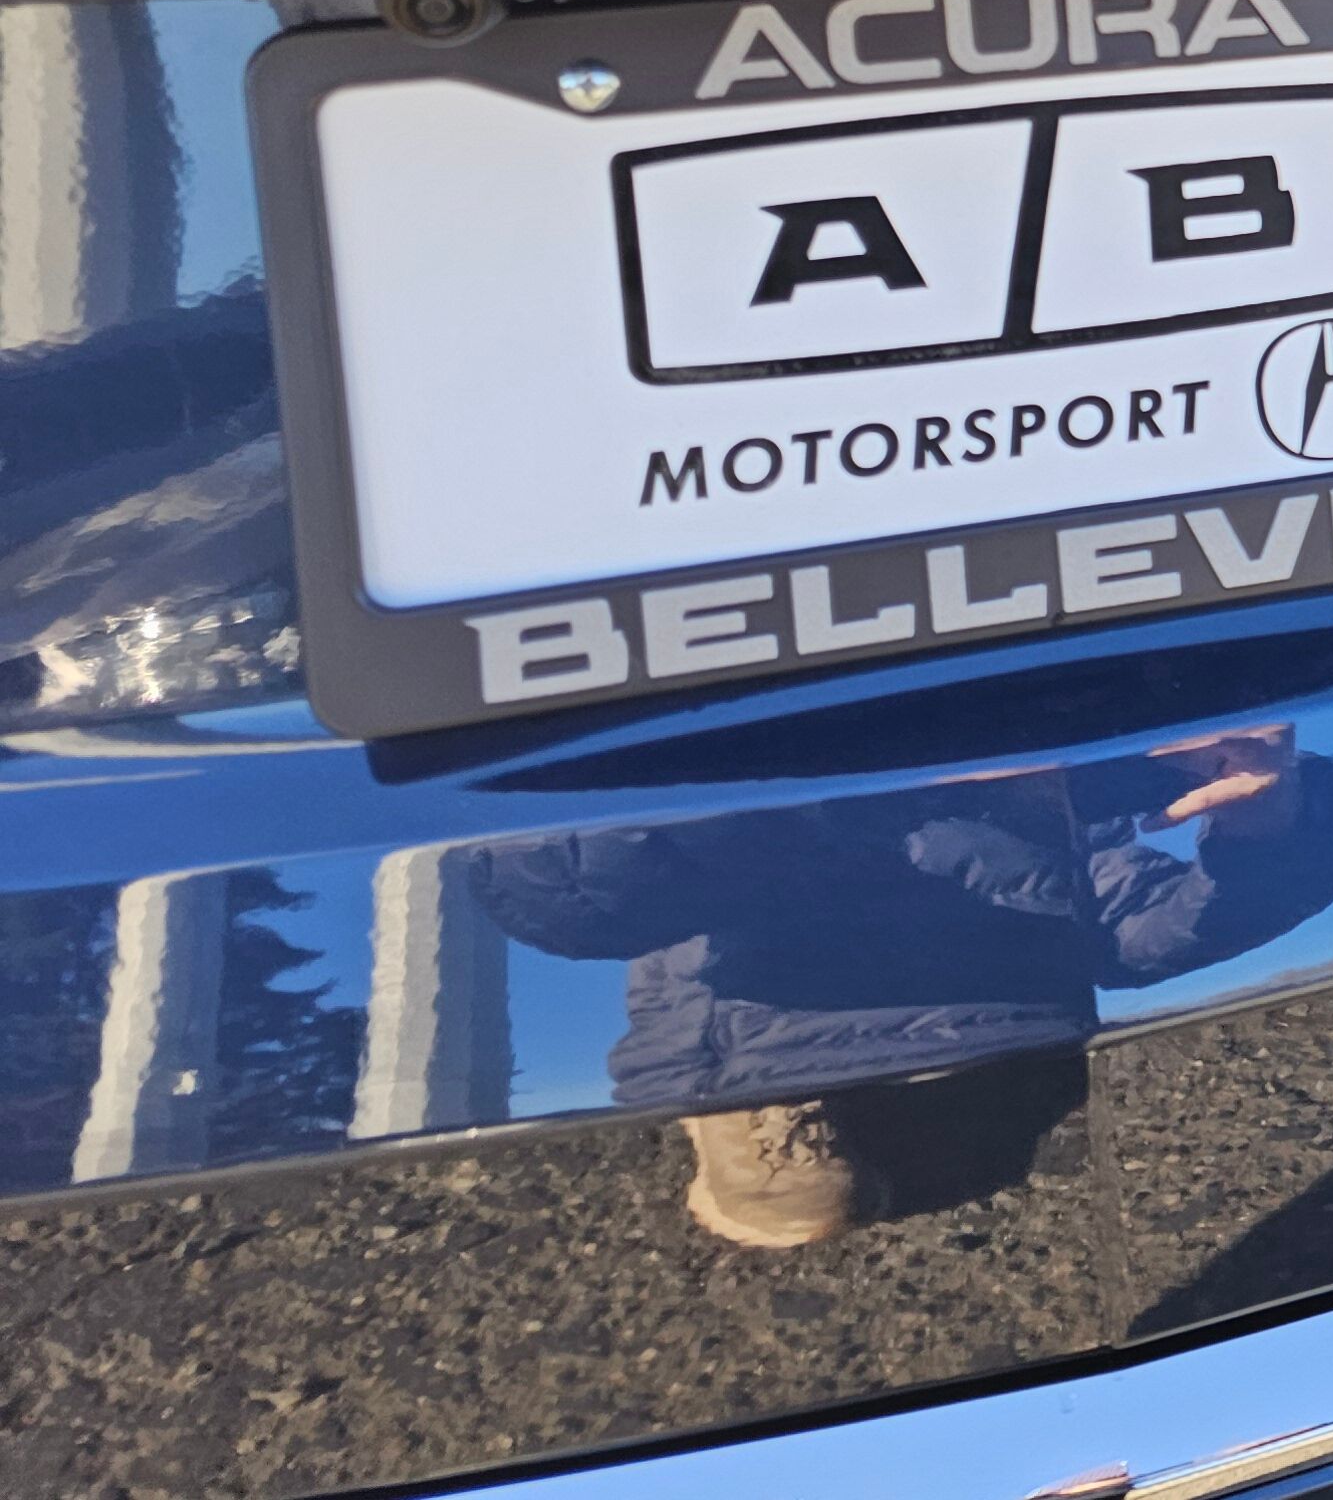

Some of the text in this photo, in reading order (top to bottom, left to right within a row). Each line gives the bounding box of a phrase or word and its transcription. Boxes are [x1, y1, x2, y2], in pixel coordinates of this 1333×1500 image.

[750, 155, 1296, 307] A B
[640, 380, 1210, 506] MOTORSPORT
